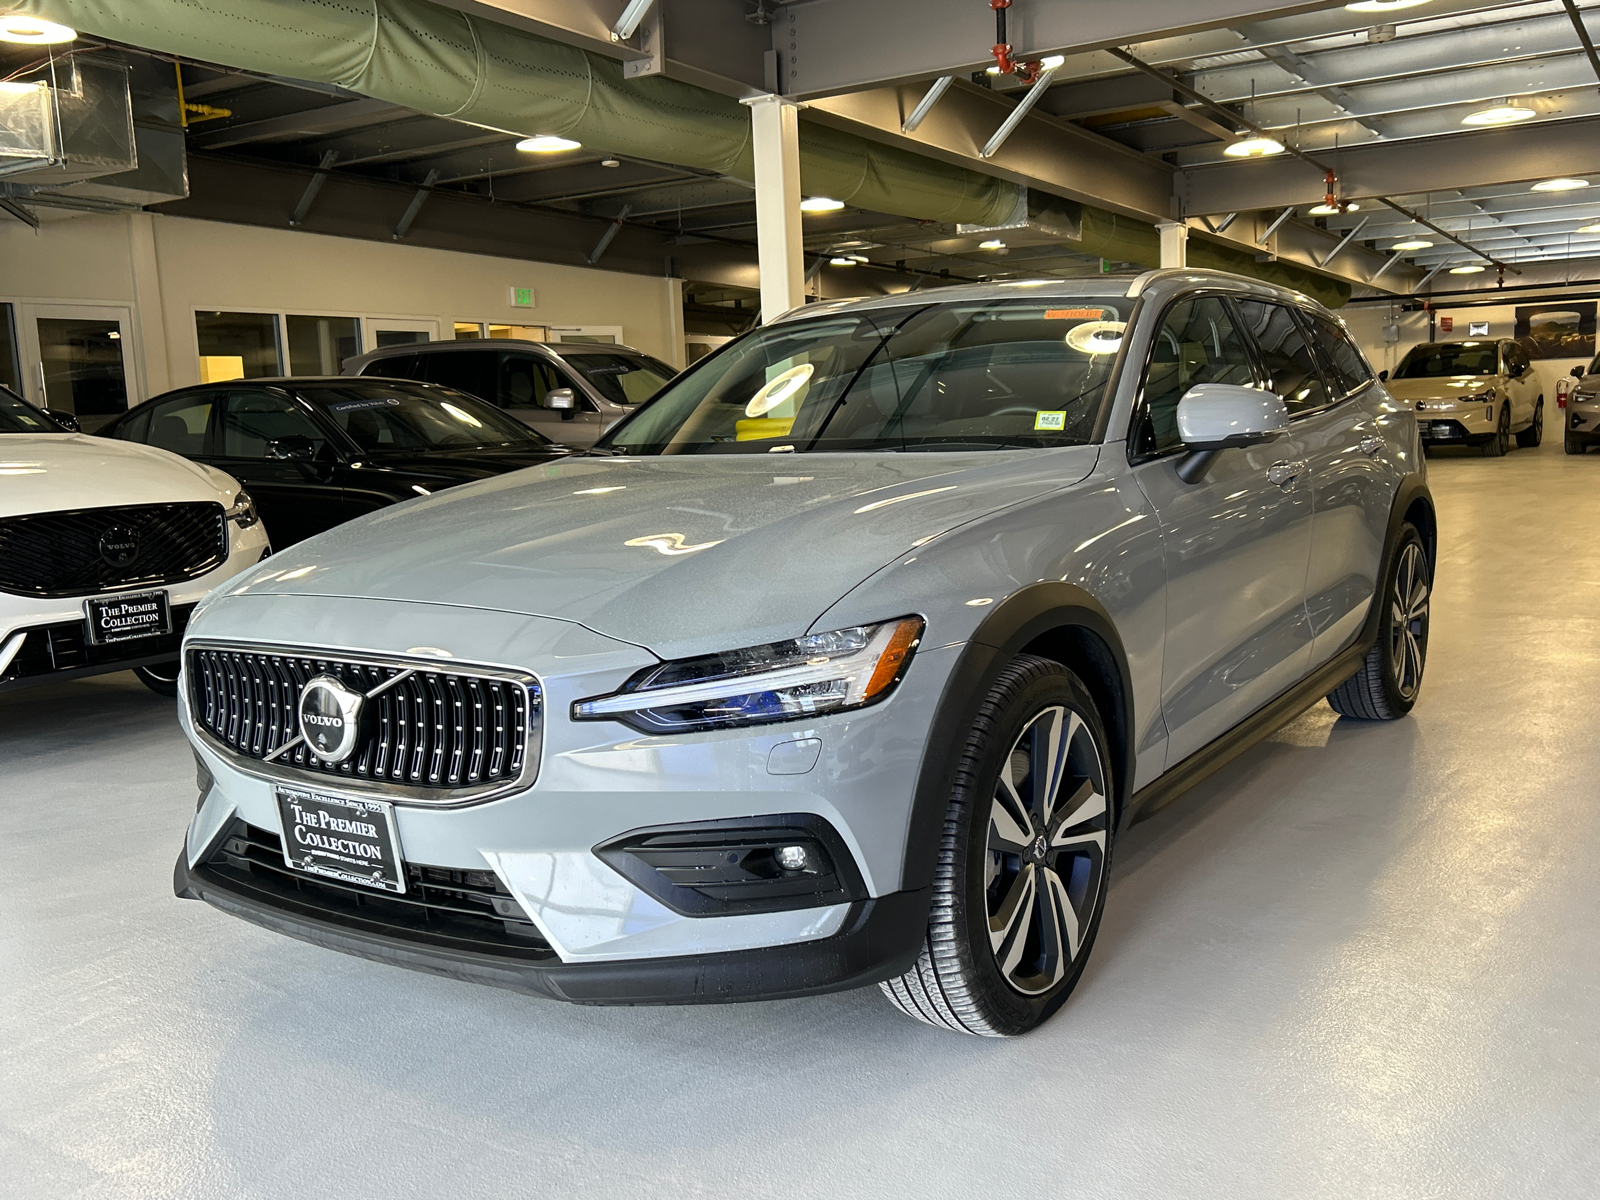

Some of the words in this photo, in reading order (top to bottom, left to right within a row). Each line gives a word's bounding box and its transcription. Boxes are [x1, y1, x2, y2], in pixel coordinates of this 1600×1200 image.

[107, 542, 136, 550] VOLVO
[100, 606, 120, 618] THE
[121, 602, 158, 615] PREMIER
[101, 613, 159, 629] COLLECTION
[303, 713, 343, 728] VOLVO
[290, 804, 319, 827] THE
[318, 810, 379, 838] PREMIER
[294, 825, 382, 860] COLLECTION
